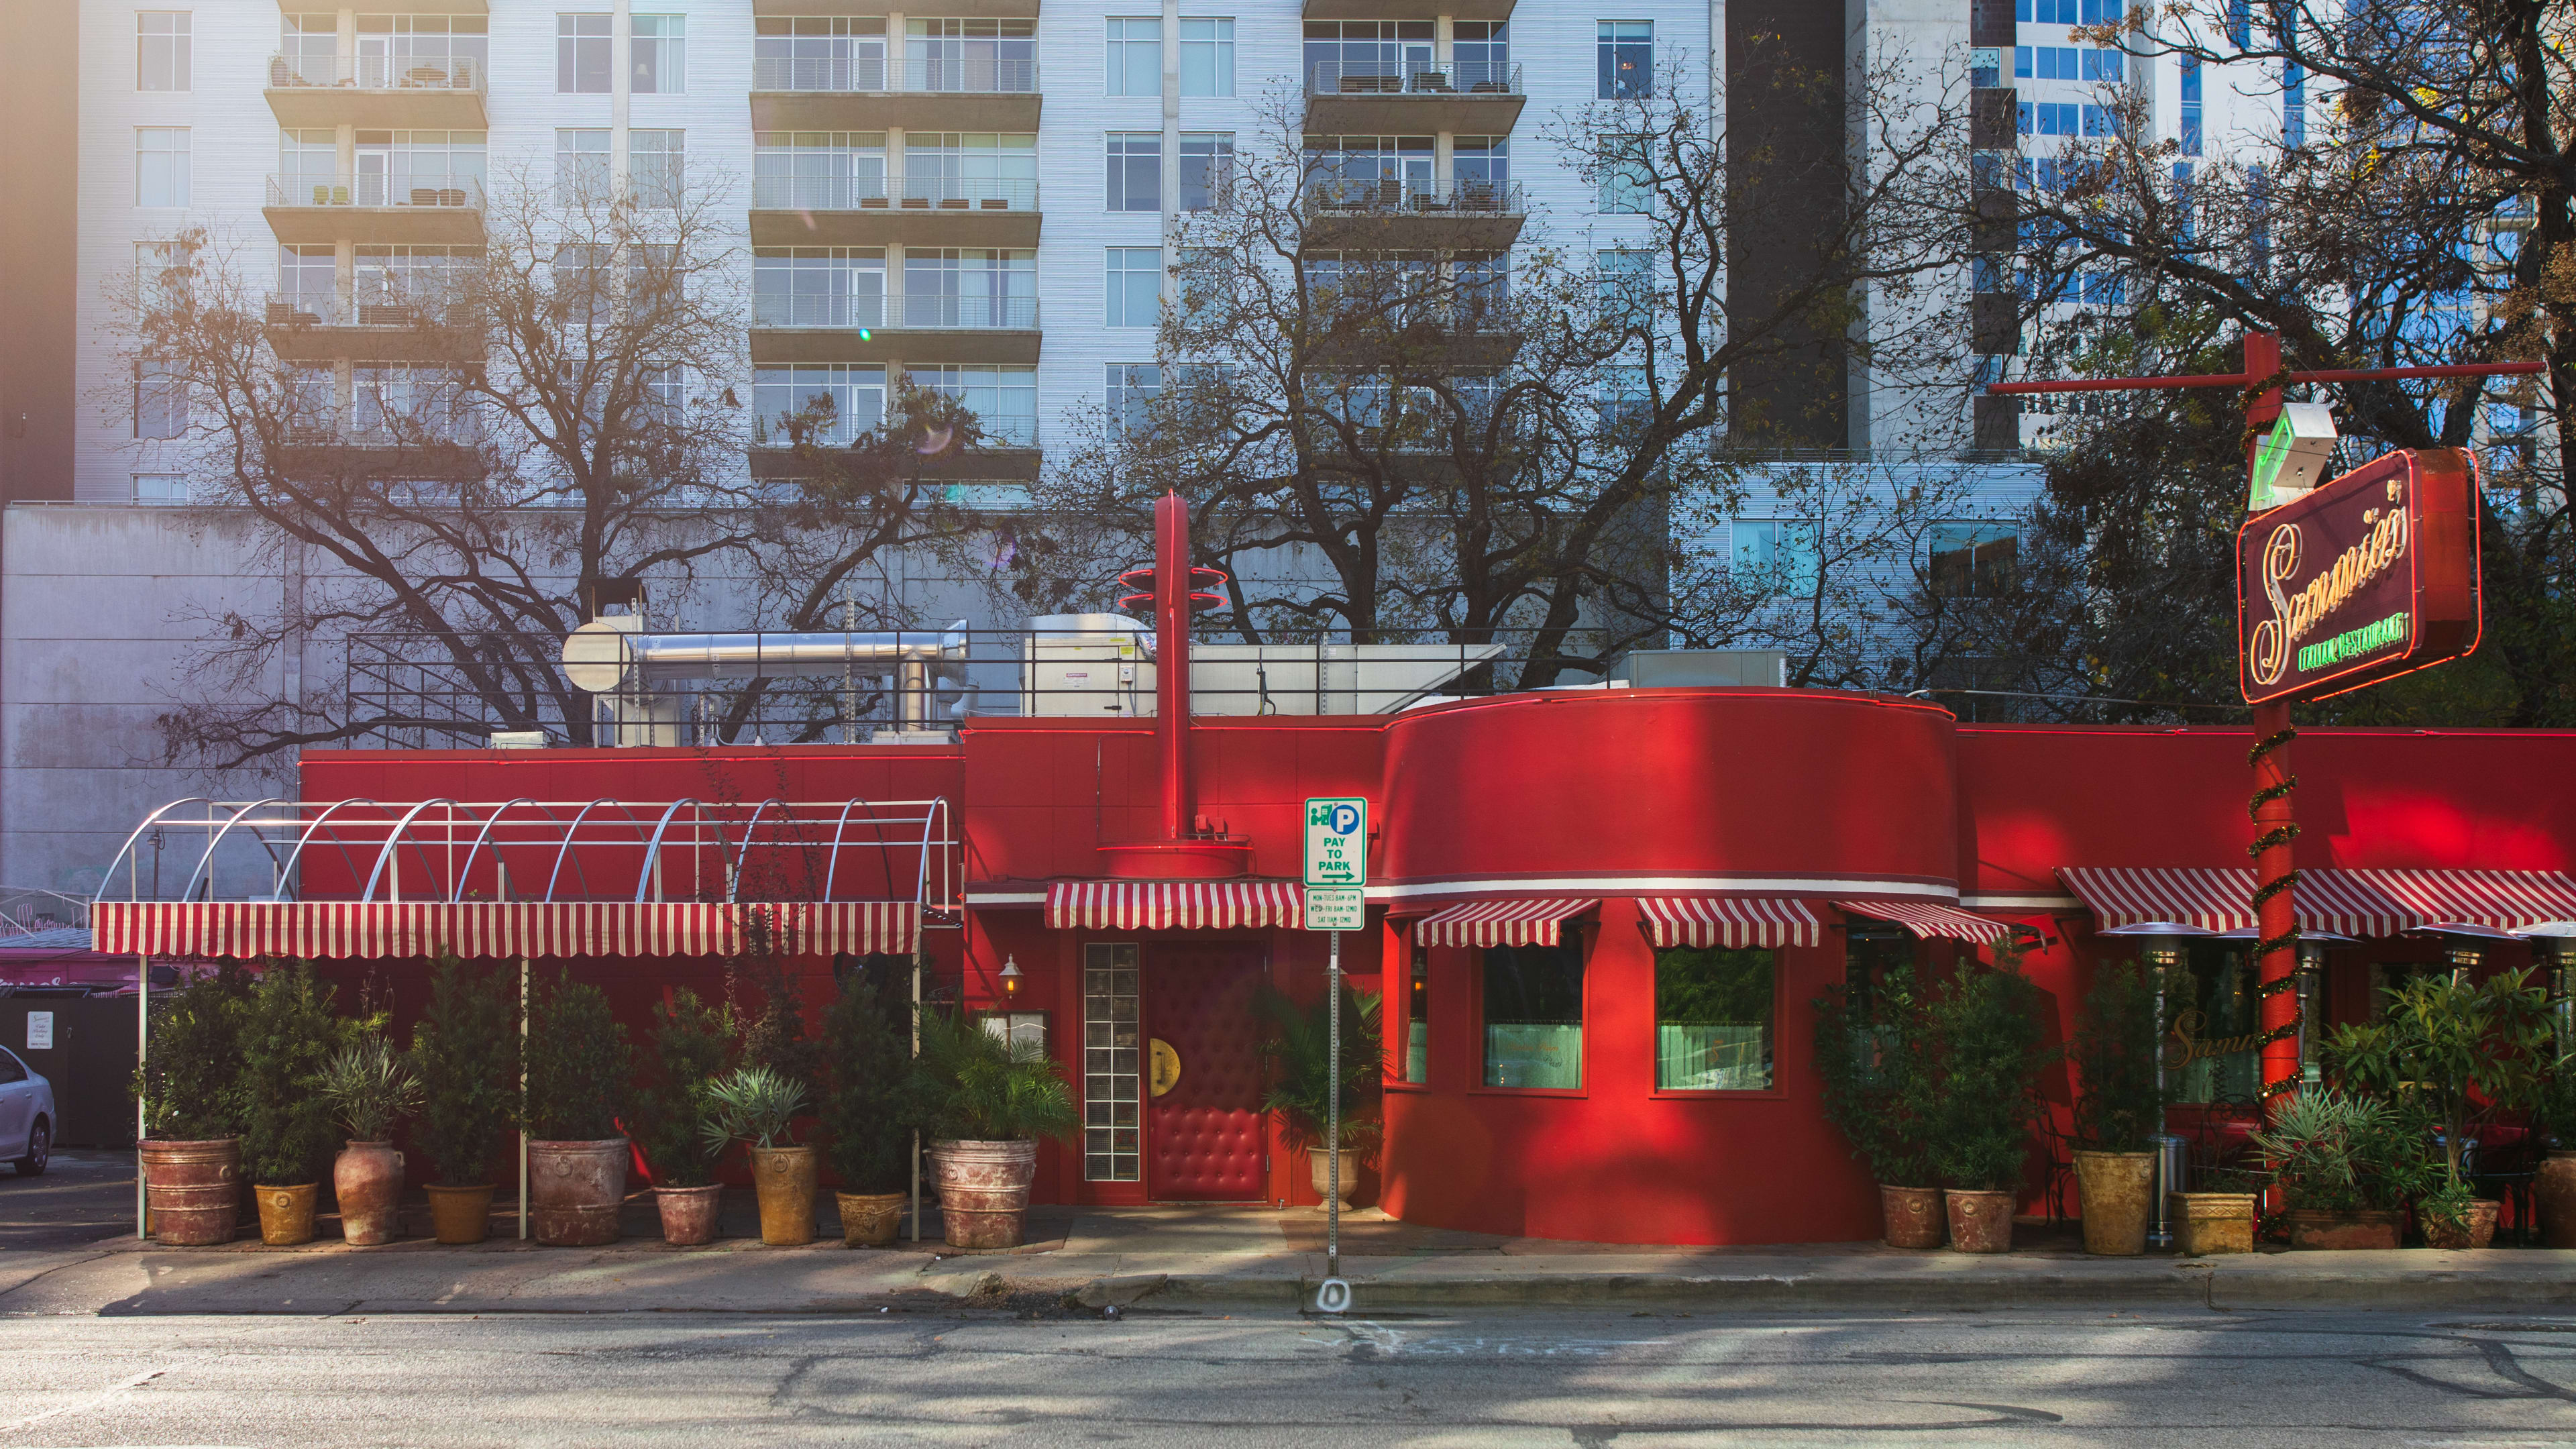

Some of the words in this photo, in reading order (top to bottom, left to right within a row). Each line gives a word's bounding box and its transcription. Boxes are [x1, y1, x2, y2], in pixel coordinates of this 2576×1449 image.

[2251, 479, 2407, 685] Sammie's
[2298, 637, 2338, 672] ITALIAN
[2338, 612, 2410, 659] RESTAURANT
[1336, 808, 1354, 833] P
[1324, 837, 1346, 847] PAY
[1326, 849, 1342, 859] TO
[1318, 861, 1350, 871] PARK
